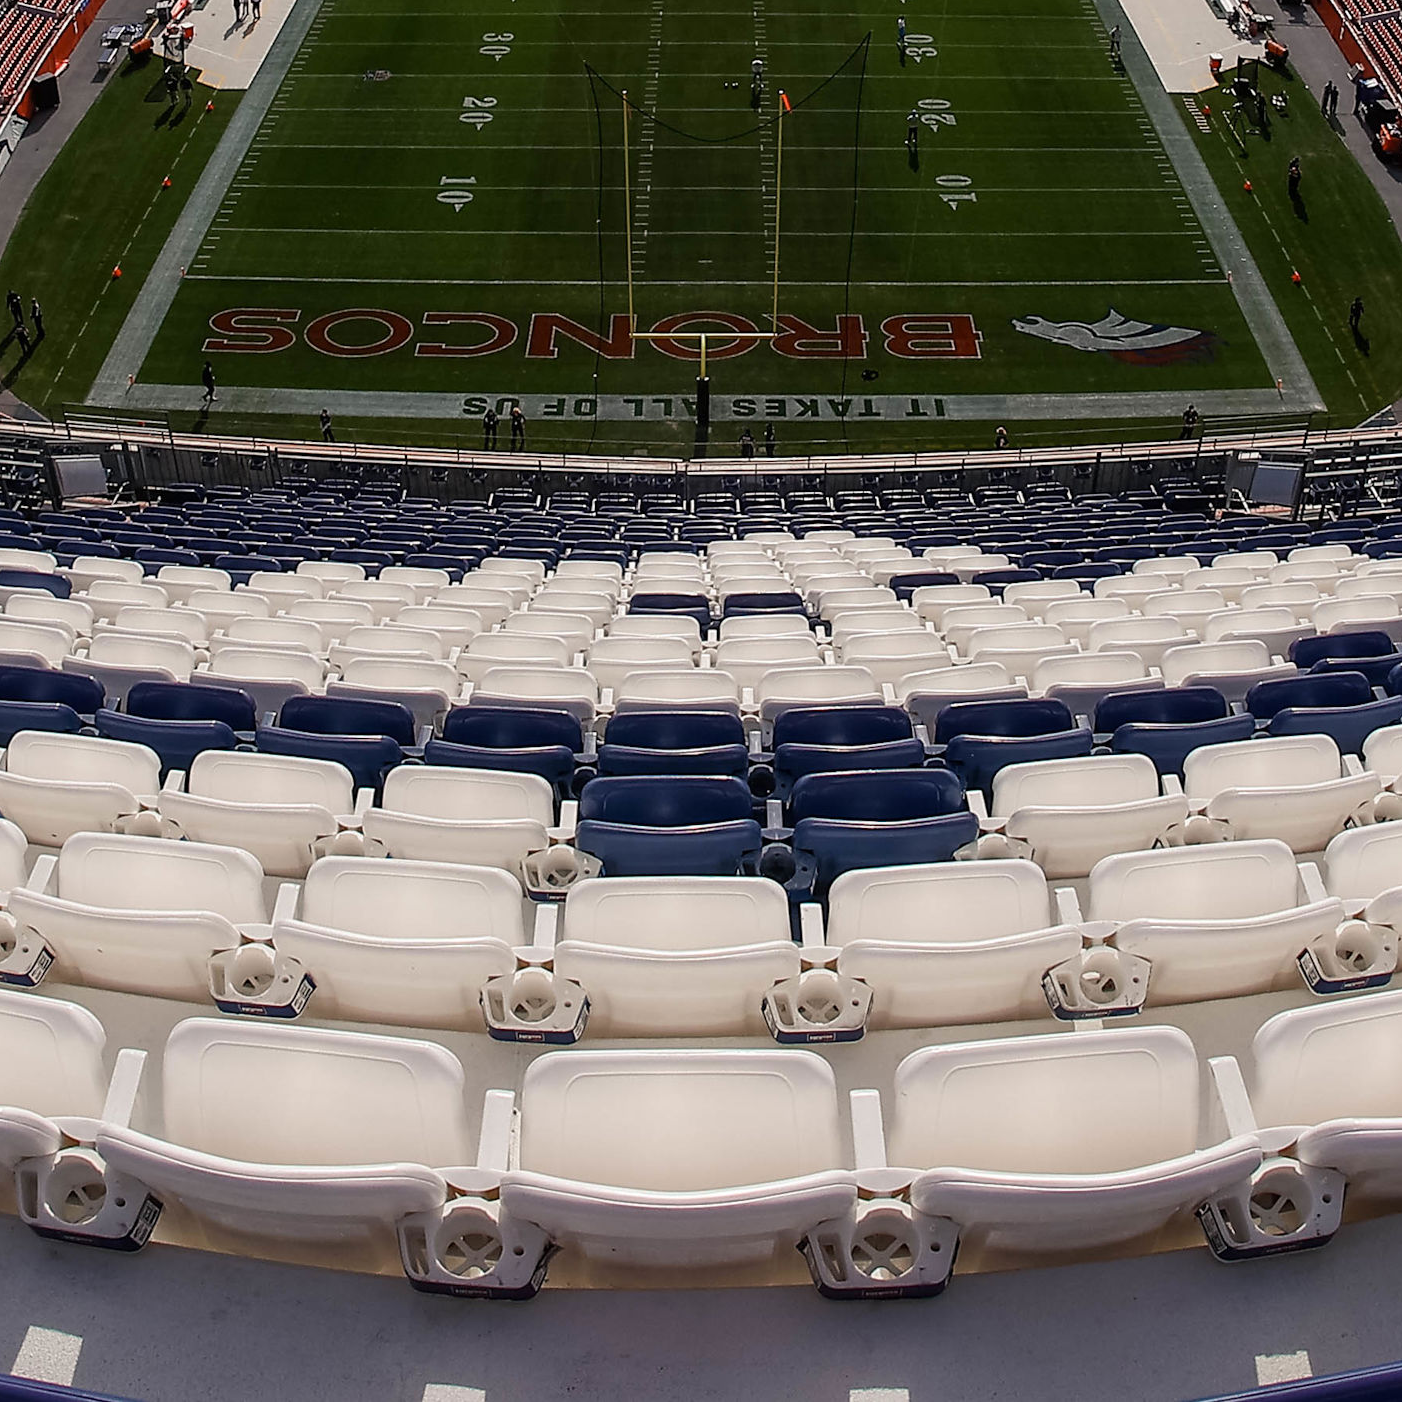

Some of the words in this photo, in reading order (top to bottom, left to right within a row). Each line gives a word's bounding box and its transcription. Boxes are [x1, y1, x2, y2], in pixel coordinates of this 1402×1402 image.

[479, 32, 514, 55] 30
[903, 33, 938, 57] 30
[459, 96, 497, 123] 20
[917, 98, 957, 126] 20
[436, 175, 477, 204] 10
[935, 174, 977, 202] 10
[201, 307, 984, 361] BRONCOS
[462, 397, 520, 416] US
[543, 397, 598, 416] OF
[623, 398, 698, 417] ALL
[731, 398, 882, 417] TAKES
[905, 398, 948, 417] IT
